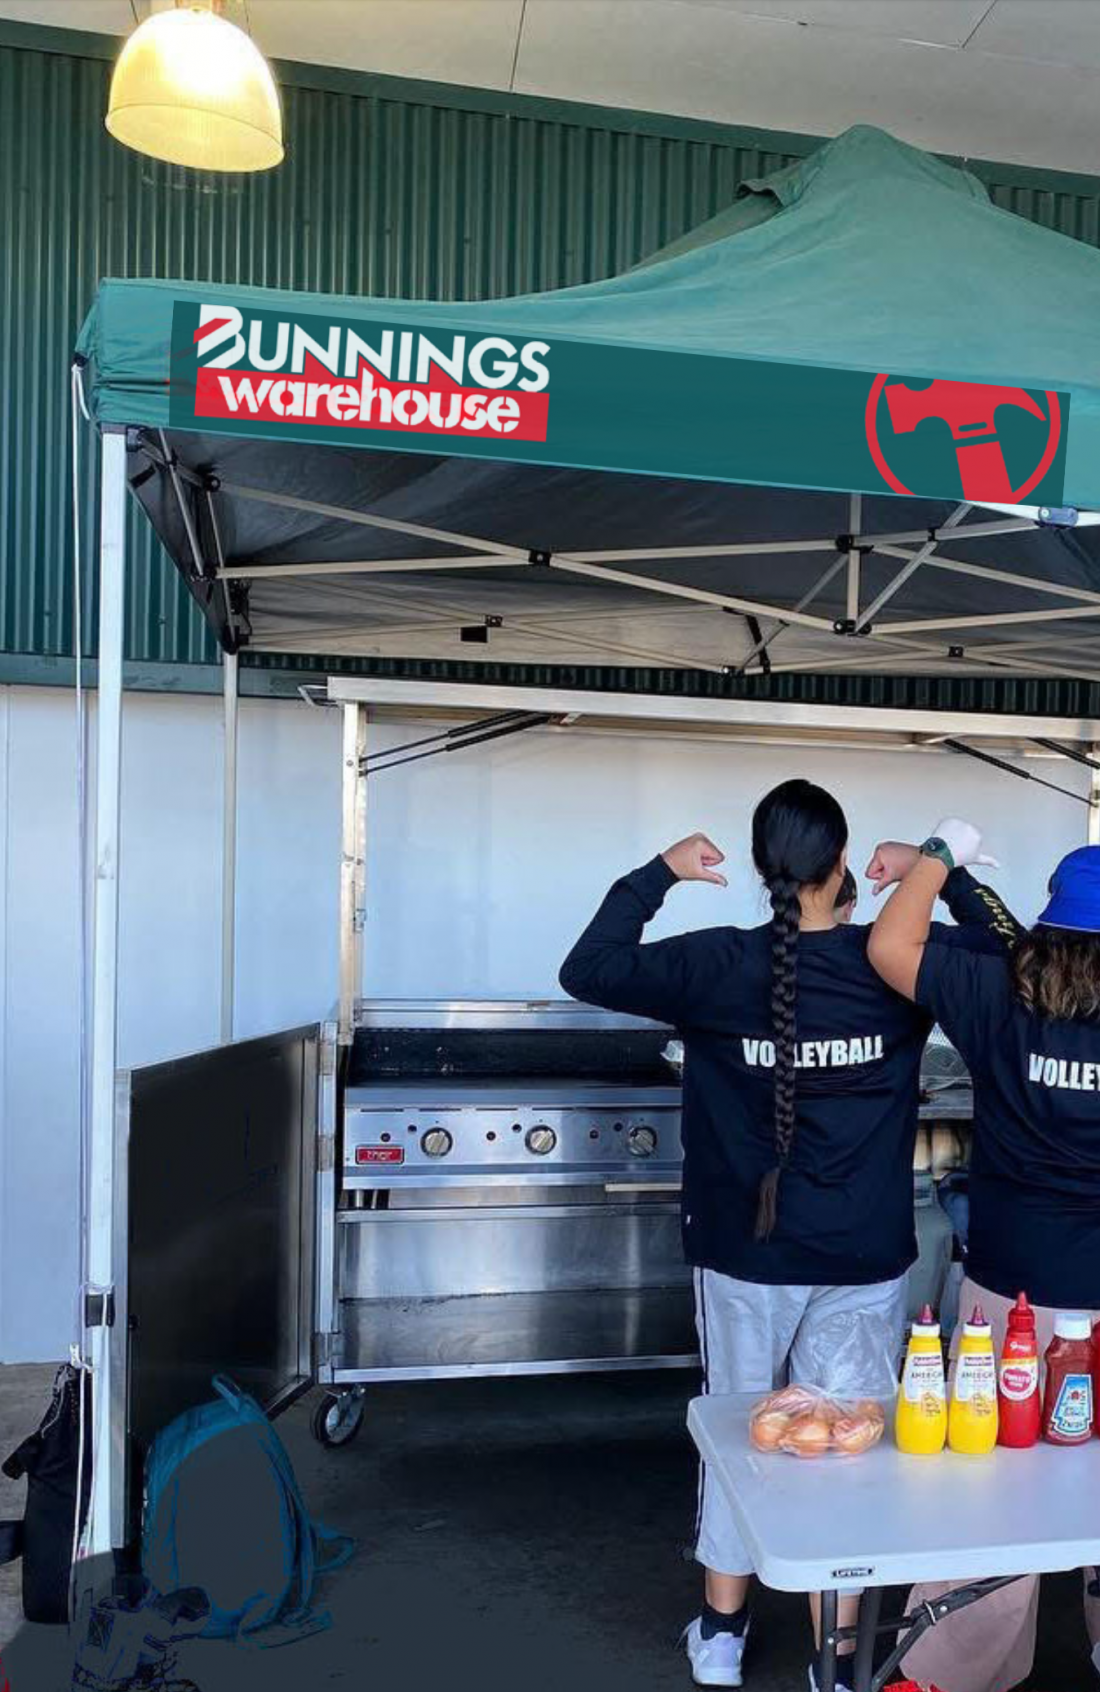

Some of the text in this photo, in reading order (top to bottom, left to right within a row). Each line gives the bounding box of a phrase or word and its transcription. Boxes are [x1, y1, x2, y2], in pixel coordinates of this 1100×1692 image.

[194, 303, 550, 392] BUNNINGS
[217, 367, 520, 433] warehouse
[742, 1035, 884, 1067] VOLEYBALL
